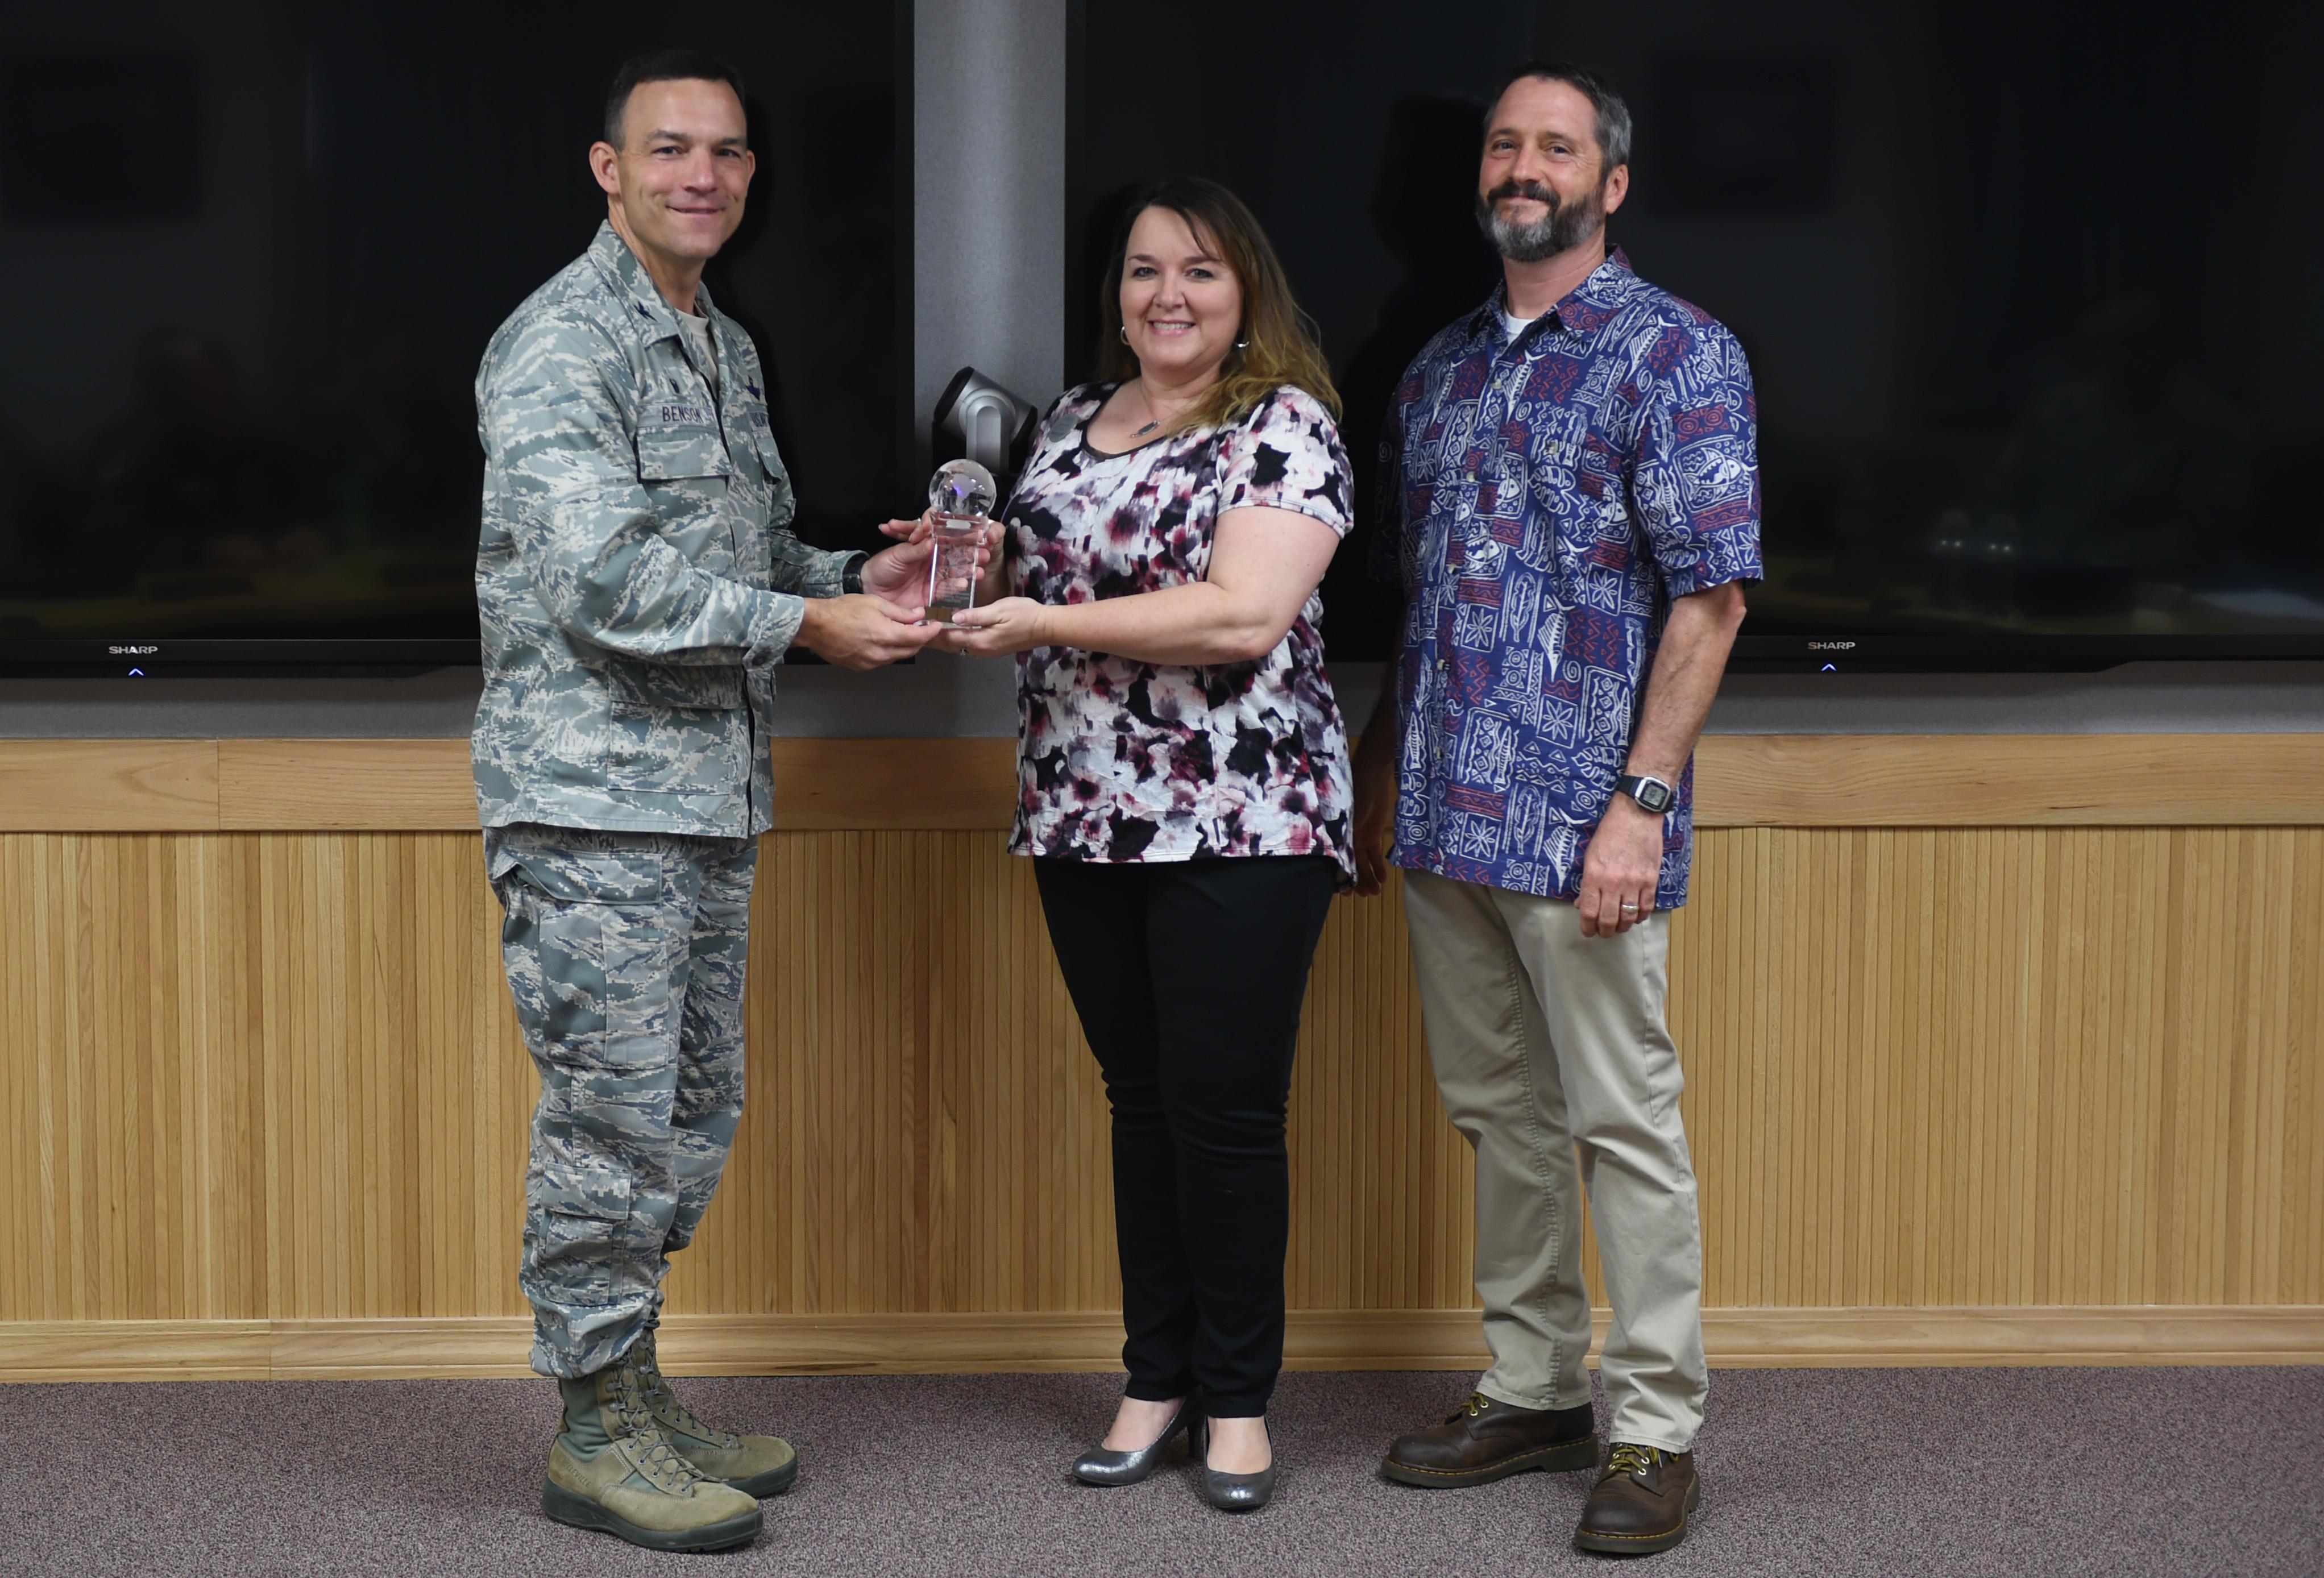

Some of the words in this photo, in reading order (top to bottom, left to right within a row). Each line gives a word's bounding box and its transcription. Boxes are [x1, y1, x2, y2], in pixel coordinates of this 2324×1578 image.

[662, 405, 704, 423] BENSON
[109, 646, 159, 654] SHARP
[1807, 641, 1856, 650] SHARP
